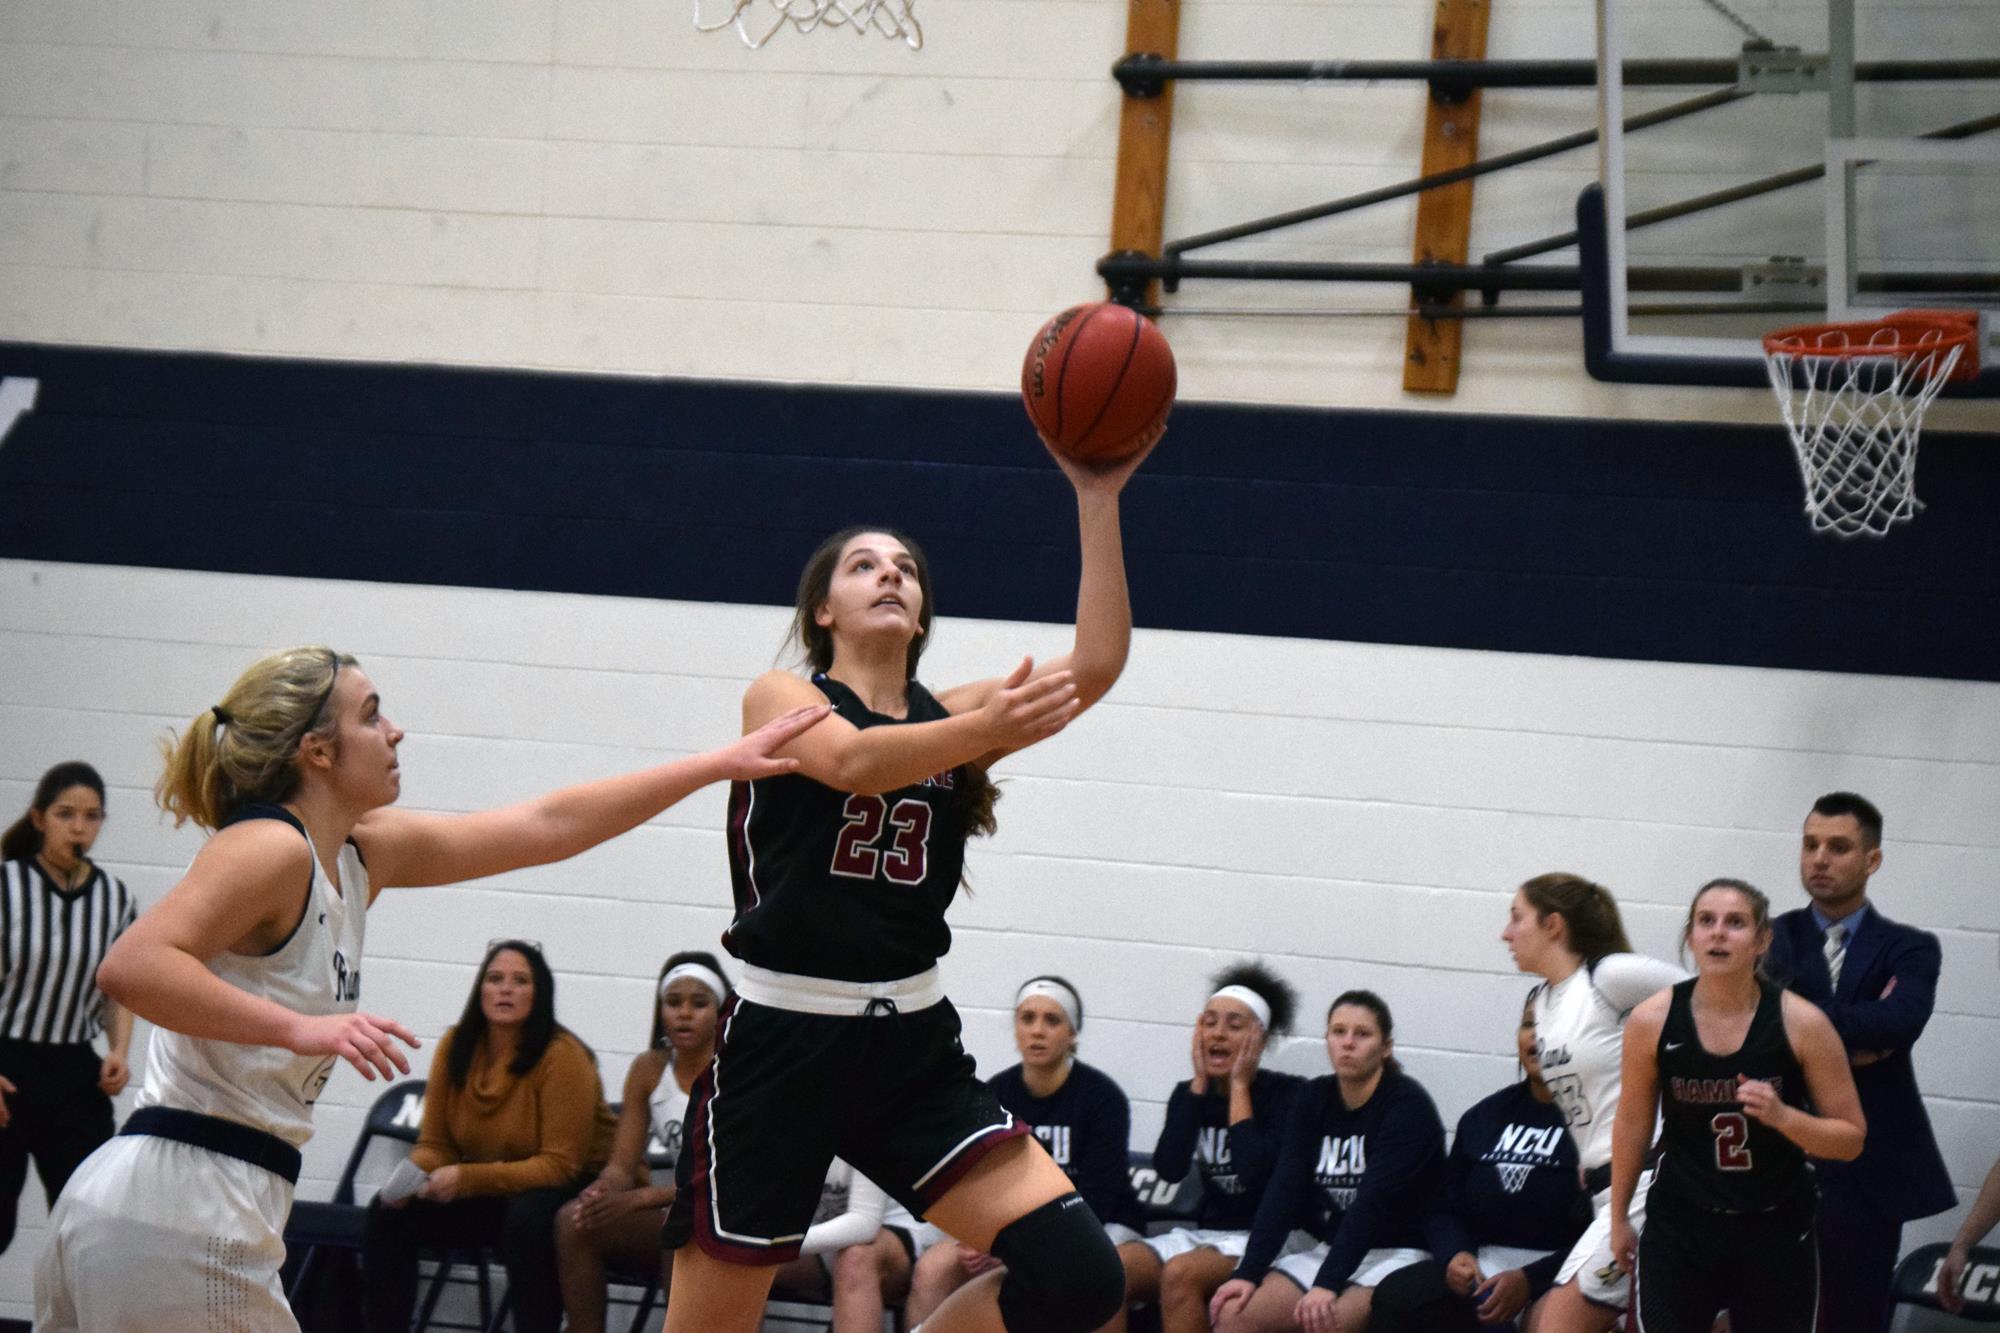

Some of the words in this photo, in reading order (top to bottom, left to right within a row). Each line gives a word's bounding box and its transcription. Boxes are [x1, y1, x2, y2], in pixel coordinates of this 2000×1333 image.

[830, 793, 933, 885] 23
[1193, 1127, 1232, 1165] NC
[1493, 1122, 1564, 1157] NCU
[1711, 1112, 1752, 1171] 2
[1129, 1167, 1182, 1205] CU
